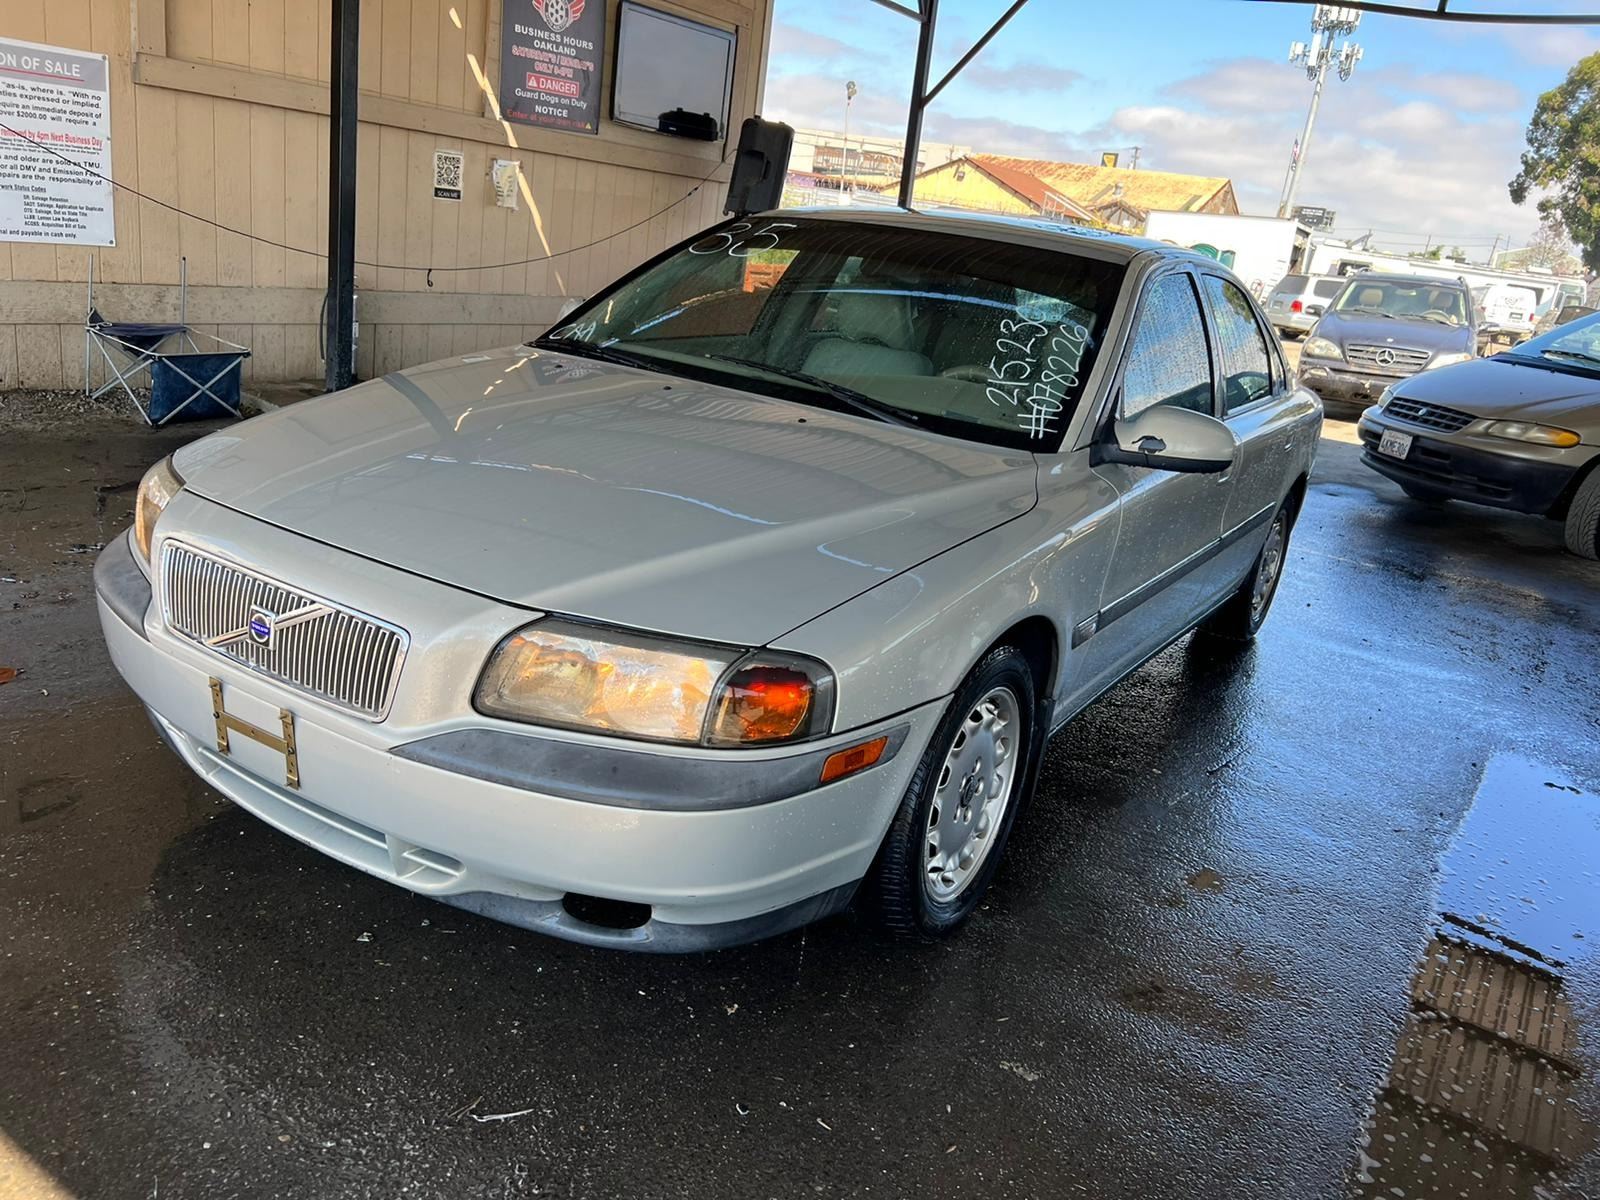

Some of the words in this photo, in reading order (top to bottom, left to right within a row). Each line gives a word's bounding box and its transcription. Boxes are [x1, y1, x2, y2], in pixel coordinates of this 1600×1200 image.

[514, 24, 561, 42] BUSINESS
[563, 36, 594, 50] HOURS
[534, 40, 576, 56] OAKLAND
[21, 56, 40, 70] OF
[44, 60, 81, 77] SALE
[30, 84, 54, 94] where
[540, 78, 576, 94] DANGER
[19, 93, 60, 105] expressed
[72, 100, 102, 109] implied.
[515, 88, 538, 100] Guard
[540, 93, 559, 104] Dogs
[571, 99, 588, 110] Duty
[16, 110, 47, 120] $2000.00
[65, 118, 89, 126] require
[32, 104, 67, 114] immediate
[69, 108, 94, 119] deposit
[507, 109, 528, 119] Enter
[535, 105, 568, 117] NOTICE
[0, 128, 26, 138] remoed
[28, 130, 36, 140] by
[37, 131, 50, 140] 4pm
[50, 132, 64, 142] Next
[65, 133, 90, 145] Business
[92, 136, 102, 148] Day
[56, 159, 72, 167] sold
[53, 168, 84, 176] Emission
[49, 176, 94, 186] responsibility
[1017, 324, 1089, 440] #078226
